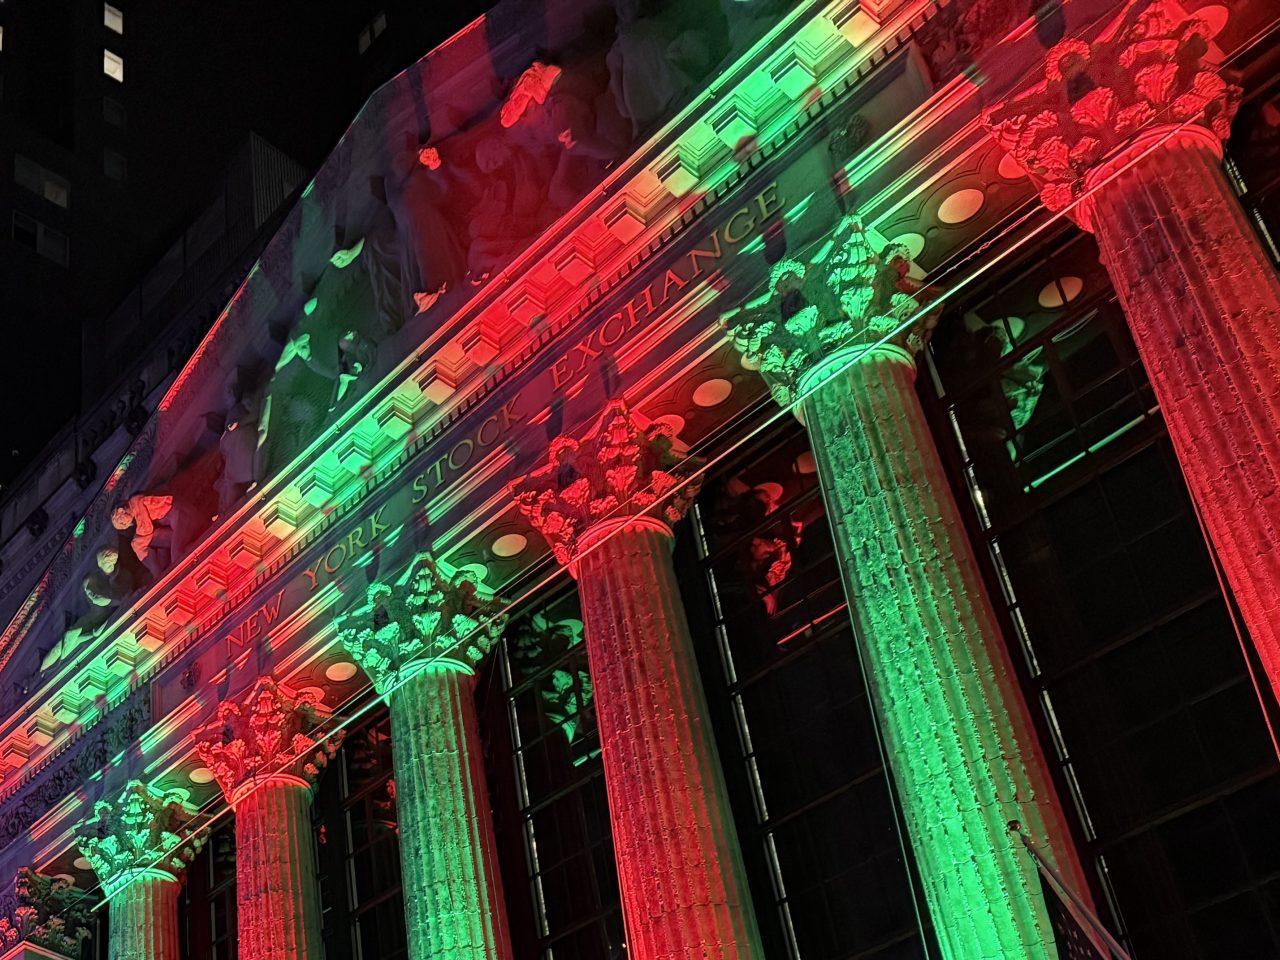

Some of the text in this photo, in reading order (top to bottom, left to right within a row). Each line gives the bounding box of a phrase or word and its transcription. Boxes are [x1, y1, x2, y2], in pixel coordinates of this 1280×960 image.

[225, 181, 786, 659] NEW YORK STOCK EXCHANGE
